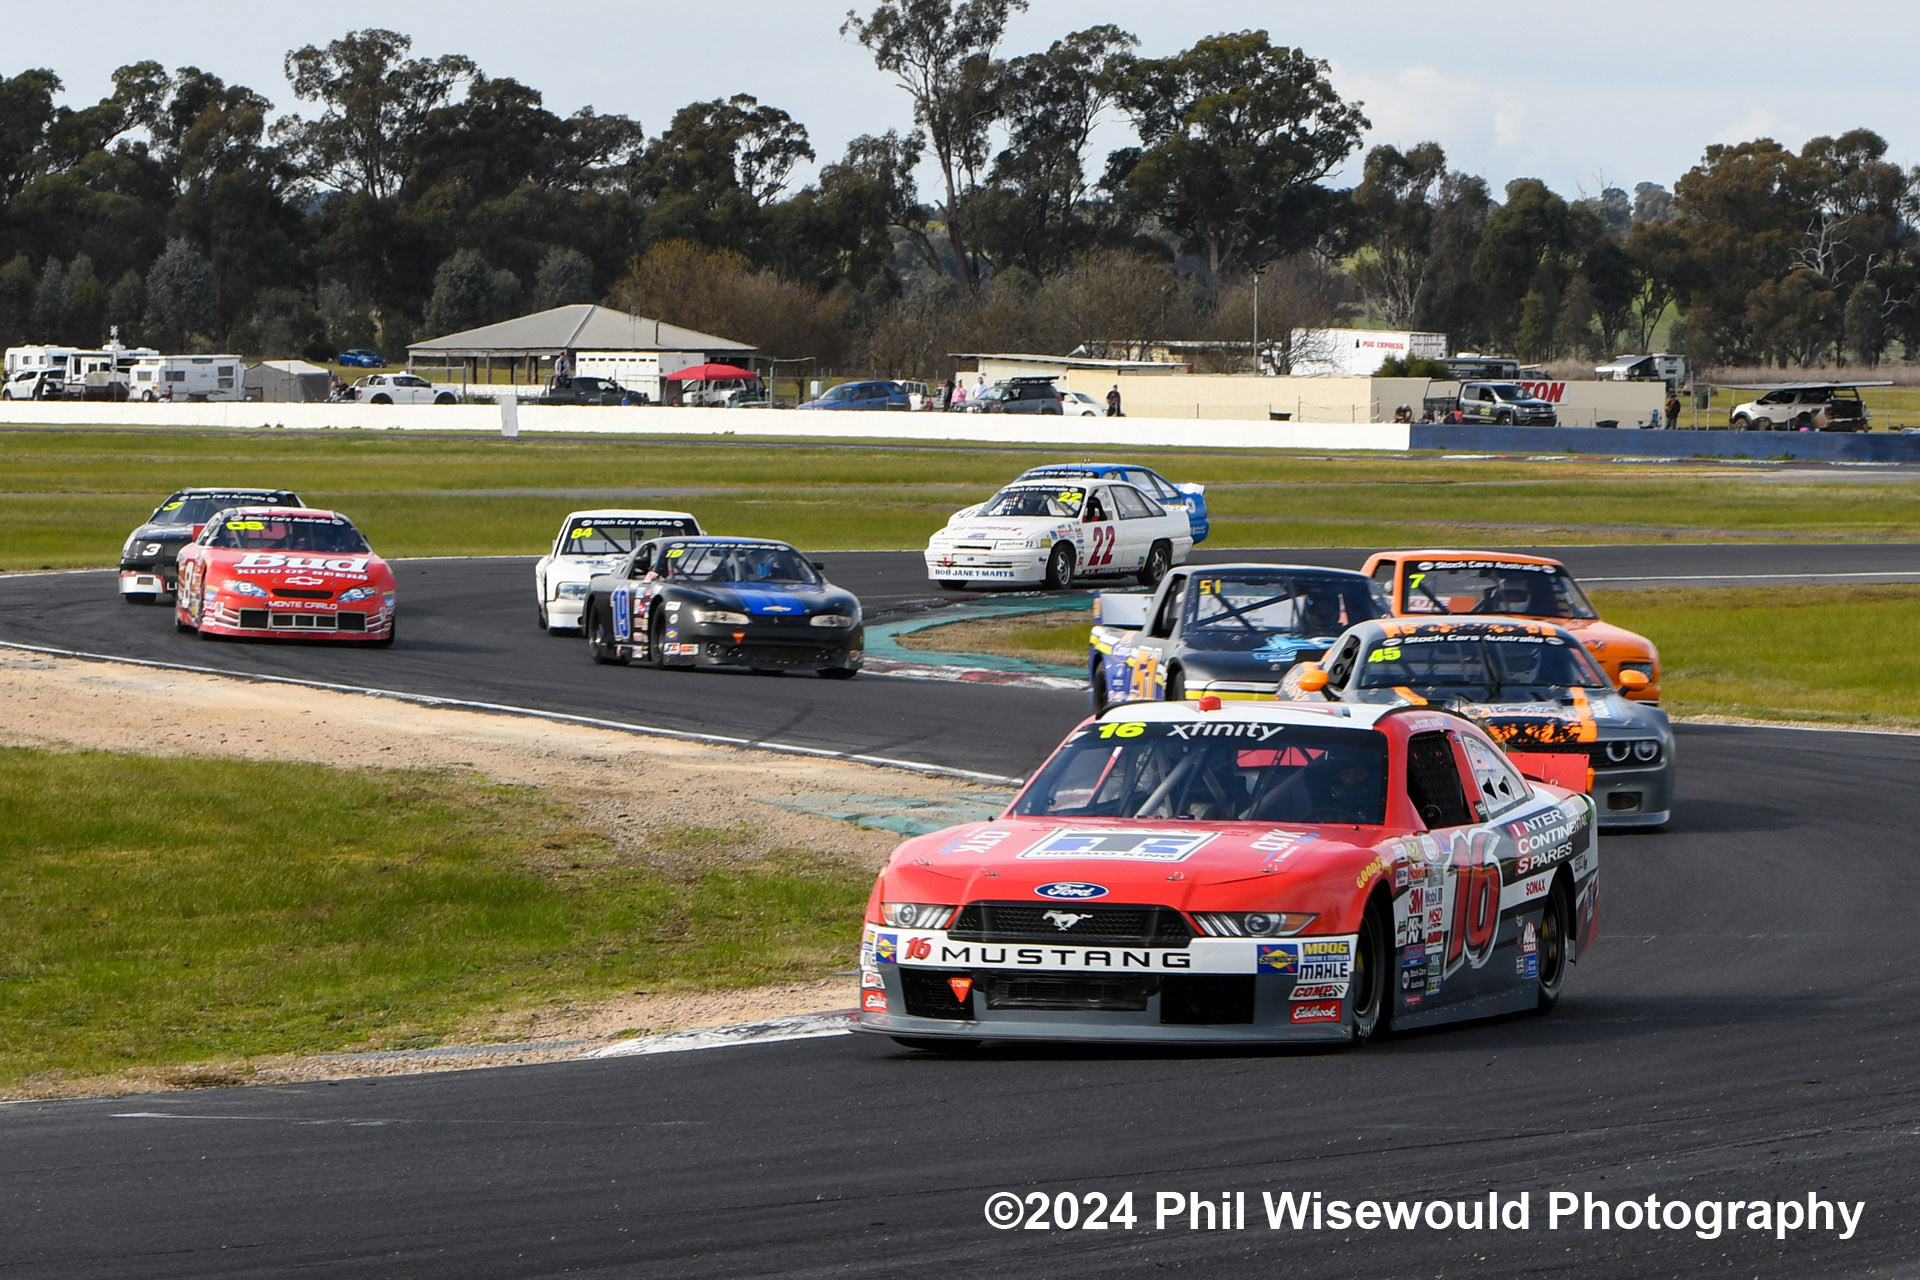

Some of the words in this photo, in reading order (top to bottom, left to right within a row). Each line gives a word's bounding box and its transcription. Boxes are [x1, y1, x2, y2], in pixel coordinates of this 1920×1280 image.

[1057, 491, 1083, 503] 22
[571, 527, 593, 539] 84
[142, 543, 161, 557] 3
[1088, 525, 1116, 566] 22
[233, 552, 370, 574] Bud
[1435, 560, 1467, 569] Stock
[1467, 560, 1494, 569] Cars
[1494, 561, 1542, 572] Australia
[312, 570, 369, 581] BEERS
[952, 569, 974, 577] JANE
[1408, 573, 1426, 589] 7
[238, 582, 252, 593] 8
[1200, 579, 1222, 595] 51
[268, 600, 303, 608] MONTE
[304, 601, 338, 610] CARLO
[1403, 635, 1445, 644] Stock
[1446, 633, 1480, 642] Cars
[1483, 634, 1545, 644] Australia
[1368, 646, 1402, 663] 45
[1098, 721, 1147, 739] 16
[1166, 721, 1284, 742] xfinity
[1511, 808, 1564, 837] INTER
[1517, 812, 1588, 855] CONTINENTAL
[1517, 841, 1573, 875] SPARES
[1047, 882, 1096, 898] Ford
[1525, 877, 1546, 897] SONAX
[1408, 887, 1423, 915] 3M
[1442, 827, 1504, 982] 16
[904, 936, 934, 960] 16
[1304, 942, 1349, 956] MOOG
[942, 946, 1191, 969] MUSTANG
[1299, 963, 1348, 980] MAHLE
[951, 980, 970, 988] TOW
[1293, 985, 1333, 998] COMP
[1293, 1005, 1337, 1020] Edelbrock
